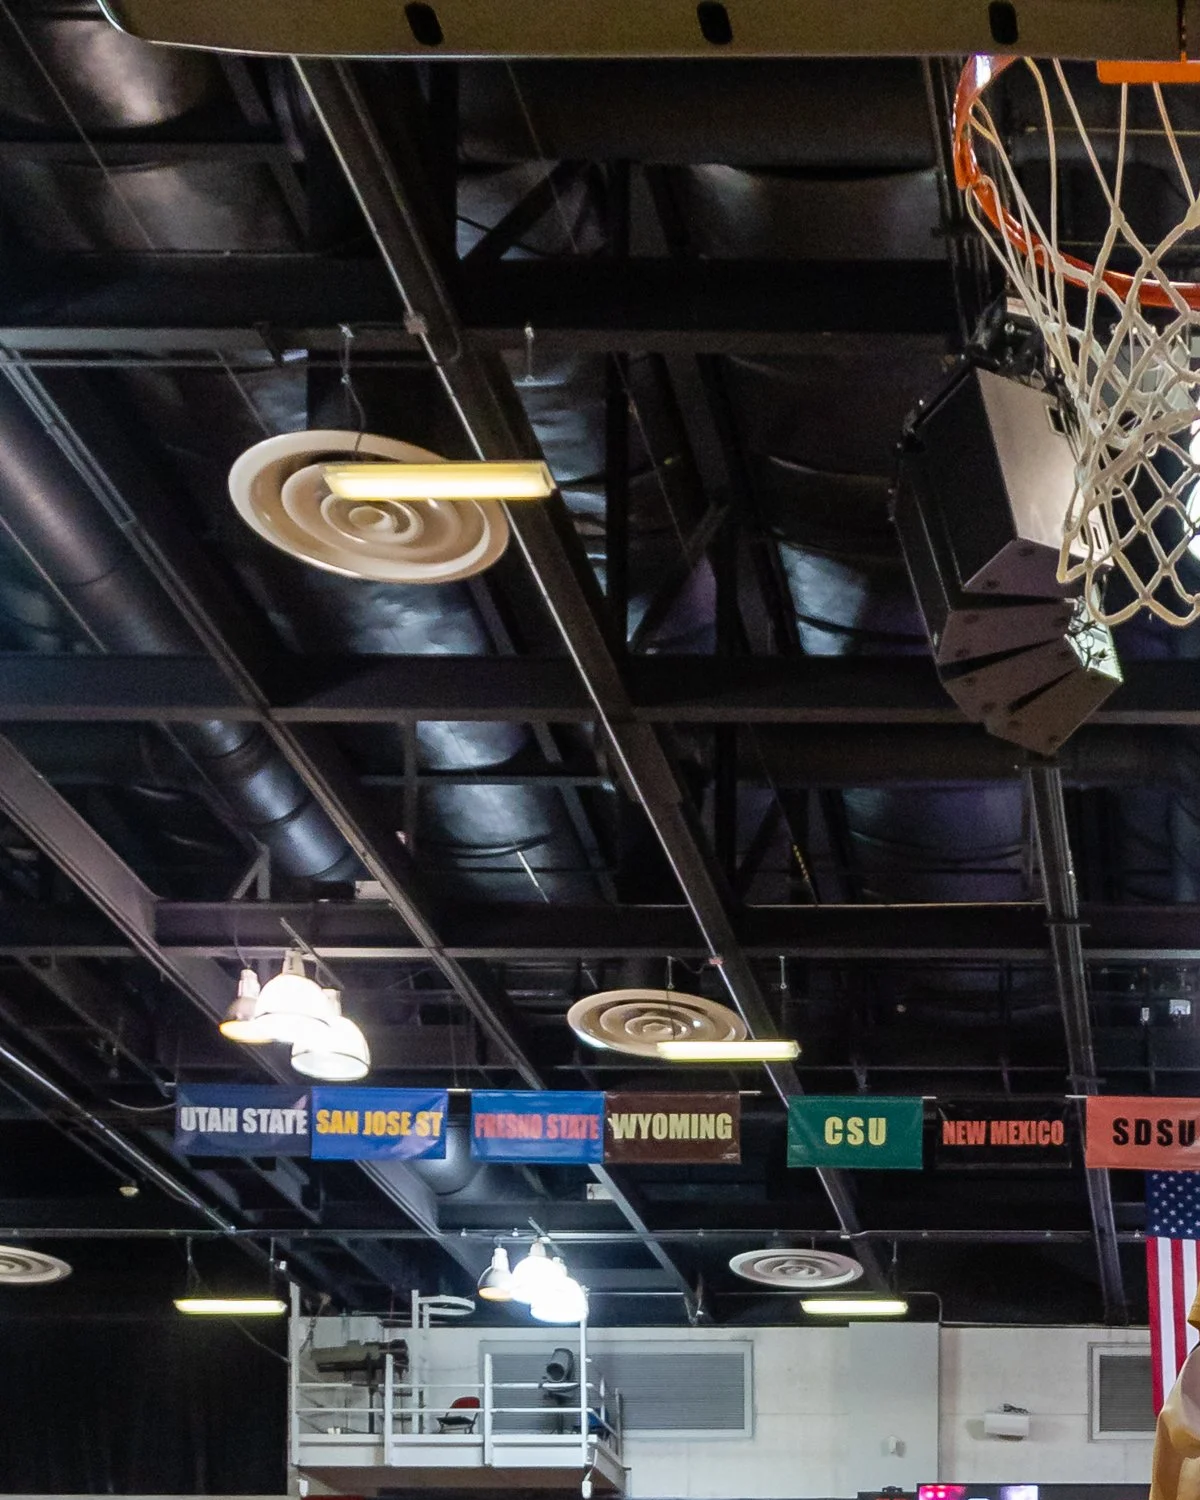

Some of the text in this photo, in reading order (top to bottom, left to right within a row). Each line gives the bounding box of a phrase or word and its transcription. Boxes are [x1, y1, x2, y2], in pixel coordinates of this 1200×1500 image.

[180, 1107, 307, 1135] UTAH STATE
[316, 1110, 443, 1137] SAN JOSE ST
[475, 1113, 599, 1139] FRESNO STATE
[610, 1113, 732, 1139] WYOMING
[824, 1116, 887, 1146] CSU
[942, 1120, 1064, 1146] NEW MEXICO
[1112, 1117, 1196, 1147] SDSU
